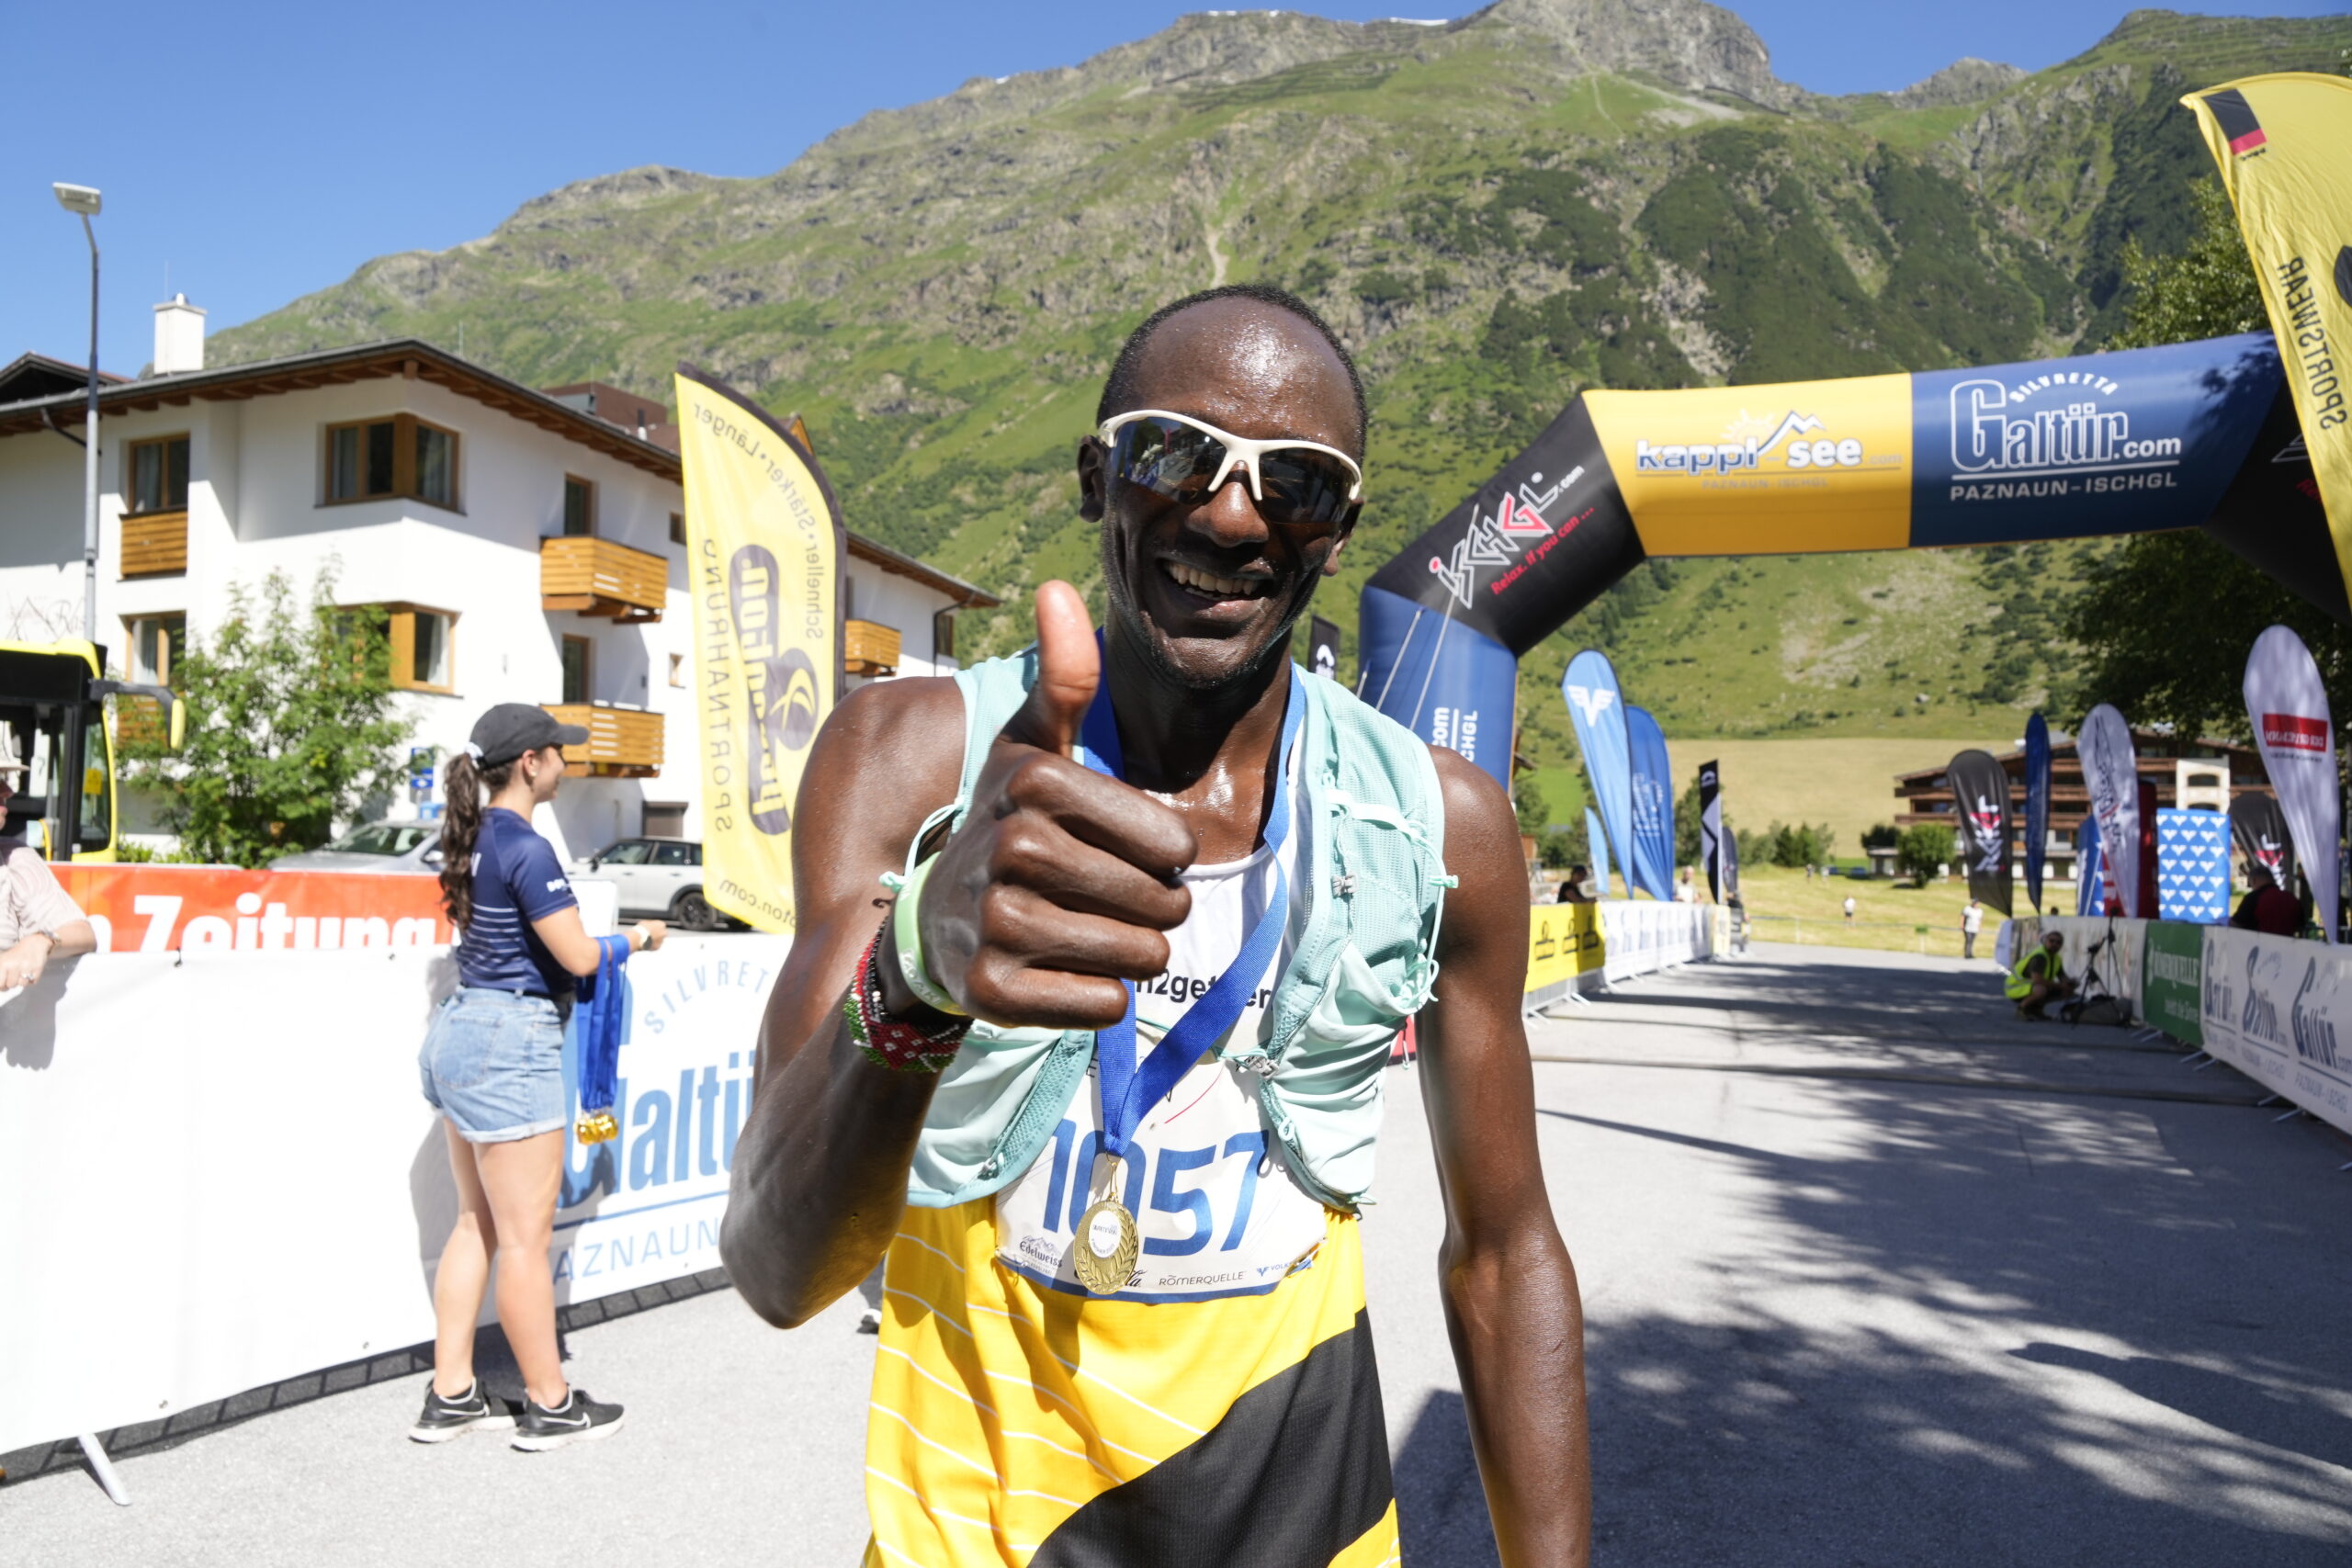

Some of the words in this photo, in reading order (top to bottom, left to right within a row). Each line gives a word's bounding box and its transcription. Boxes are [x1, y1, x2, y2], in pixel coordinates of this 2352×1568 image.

[2009, 372, 2119, 402] SILVRETTA
[1636, 436, 1758, 476] kappl
[1490, 564, 1529, 595] Relax.
[1535, 535, 1560, 560] you
[1557, 515, 1580, 539] can
[134, 893, 436, 952] Zeitung
[644, 958, 769, 1034] SILVRET
[1043, 1118, 1269, 1258] 1057
[553, 1217, 720, 1284] AZNAUN
[1020, 1240, 1063, 1268] Edelweiss
